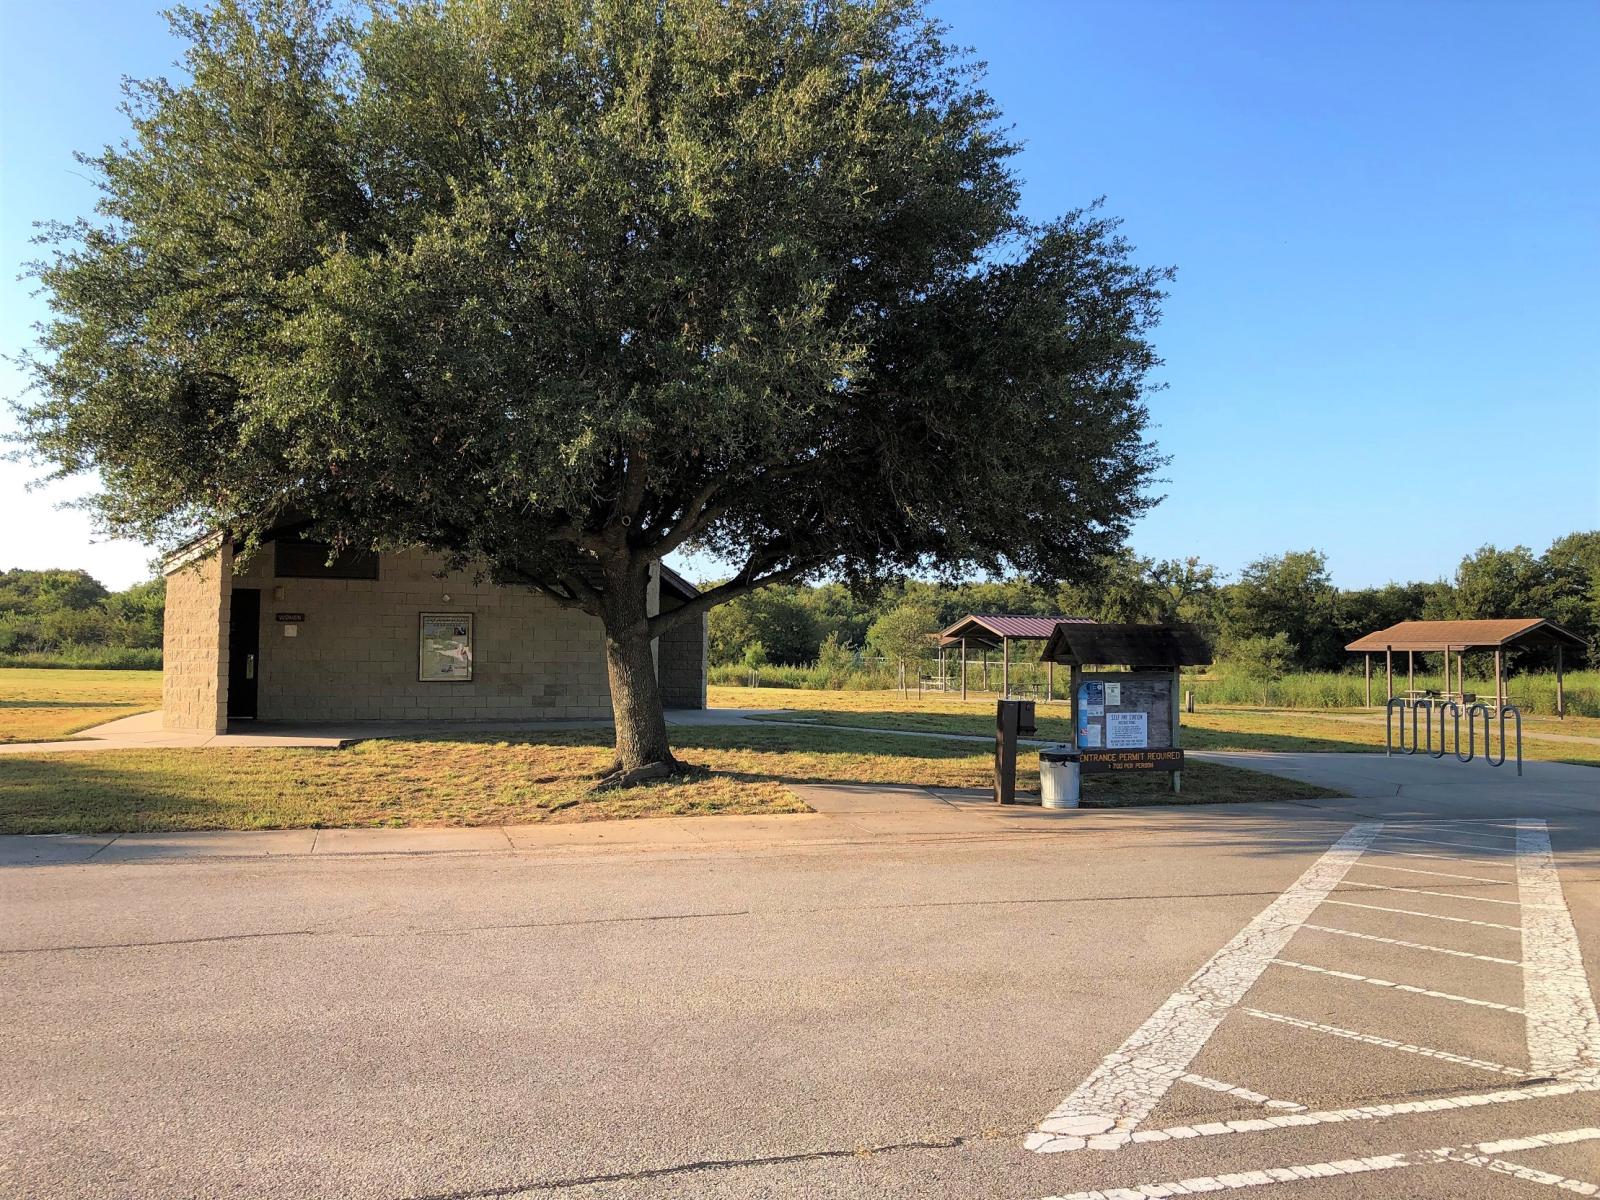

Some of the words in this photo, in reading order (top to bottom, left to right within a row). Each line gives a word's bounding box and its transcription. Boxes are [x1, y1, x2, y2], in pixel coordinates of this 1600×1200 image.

[1080, 753, 1117, 763] ENTRANCE
[1119, 752, 1145, 762] PERMIT
[1147, 751, 1181, 761] REQUIRED
